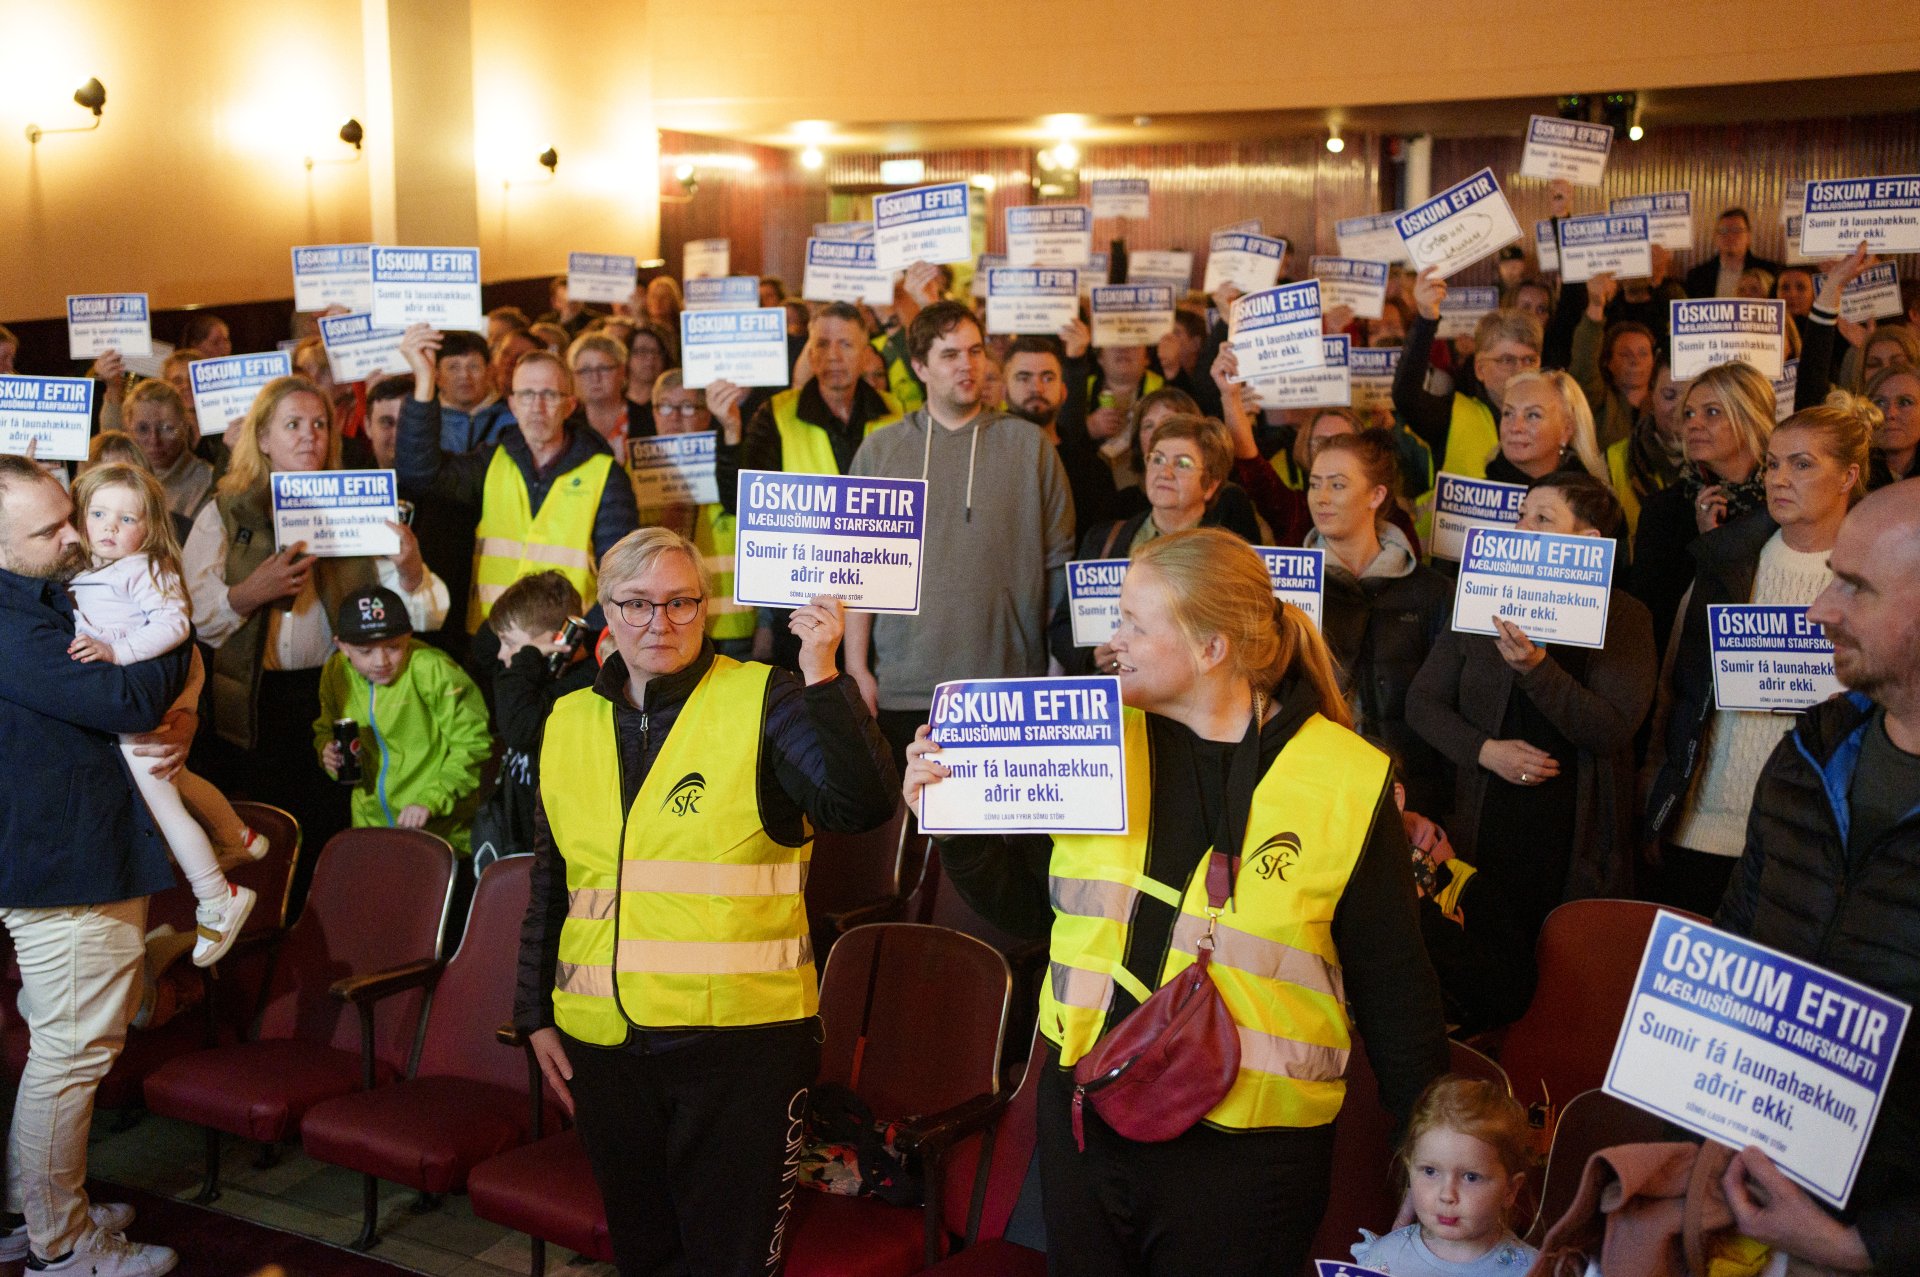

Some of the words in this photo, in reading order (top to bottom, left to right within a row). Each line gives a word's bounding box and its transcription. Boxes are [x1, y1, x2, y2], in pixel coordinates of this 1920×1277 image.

[1813, 183, 1869, 201] ÓSKUM
[1875, 180, 1920, 197] EFTIR
[879, 195, 922, 216] ÓSKUM
[926, 189, 962, 209] EFTIR
[1401, 206, 1450, 236] ÓSKUM
[1452, 176, 1492, 208] EFTIR
[1564, 221, 1606, 237] ÓSKUM
[1610, 218, 1643, 233] EFTIR
[1810, 218, 1836, 228] Sumir
[1839, 218, 1848, 227] fá
[1852, 214, 1920, 227] launahækkun,
[1838, 229, 1860, 239] aðrir
[1864, 228, 1888, 238] ekki.
[377, 249, 427, 269] ÓSKUM
[433, 254, 472, 270] EFTIR
[1280, 287, 1318, 311] EFTIR
[688, 314, 735, 333] ÓSKUM
[741, 314, 779, 330] EFTIR
[1678, 304, 1734, 324] ÓSKUM
[1740, 305, 1777, 323] EFTIR
[1256, 336, 1264, 347] fá
[1678, 341, 1705, 351] Sumir
[1709, 341, 1718, 349] fá
[1721, 341, 1777, 351] launahækkun,
[1258, 348, 1278, 361] aðrir
[1282, 344, 1302, 356] ekki.
[1708, 353, 1731, 363] aðrir
[196, 362, 245, 382] ÓSKUM
[248, 357, 286, 375] EFTIR
[0, 376, 37, 397] SKUM
[42, 382, 86, 400] EFTIR
[9, 416, 17, 426] fá
[21, 416, 84, 431] launahækkun,
[8, 429, 28, 440] aðrir
[279, 475, 336, 495] ÓSKUM
[342, 476, 388, 494] EFTIR
[1443, 481, 1502, 508] ÓSKUM
[750, 476, 836, 512] ÓSKUM
[845, 487, 914, 516] EFTIR
[1442, 502, 1497, 519] NÆGJUSÖMUM
[748, 510, 830, 529] NÆGJUSÖMUM
[834, 516, 913, 534] STARFSKRAFTI
[1439, 519, 1467, 533] Sumir
[746, 541, 787, 559] Sumir
[792, 543, 805, 560] fá
[811, 544, 912, 568] launahækkun,
[1471, 530, 1541, 562] ÓSKUM
[1546, 542, 1604, 568] EFTIR
[791, 565, 824, 583] aðrir
[829, 567, 864, 585] ekki.
[1266, 555, 1315, 576] EFTIR
[1468, 556, 1534, 574] NÆGJUSÖMUM
[1536, 565, 1602, 582] STARFSKRAFTI
[1076, 587, 1120, 596] NÆGJUSÖM
[1273, 577, 1315, 589] RFSKRAFTI
[848, 593, 863, 601] STÖRF
[1464, 580, 1498, 596] Sumir
[1501, 585, 1513, 598] fá
[1516, 587, 1600, 610] launahækkun,
[1078, 605, 1107, 616] Sumir
[1110, 605, 1119, 616] fá
[1499, 602, 1527, 617] aðrir
[1530, 605, 1558, 620] ekki.
[1718, 608, 1787, 634] ÓSKUM
[1719, 636, 1785, 648] NÆGJUSÖMUM
[1788, 638, 1834, 649] STARFSKR
[1721, 660, 1754, 672] Sumir
[1759, 660, 1769, 673] fá
[1774, 661, 1834, 675] launahækk
[1759, 678, 1785, 690] aðrir
[1790, 679, 1816, 691] ekki.
[935, 687, 1024, 723] ÓSKUM
[1034, 689, 1108, 721] EFTIR
[932, 726, 1021, 742] NÆGJUSÖMUM
[1025, 725, 1111, 740] STARFSKRAFTI
[984, 760, 998, 777] fá
[1005, 759, 1113, 780] launahækkun,
[985, 785, 1021, 802] aðrir
[1028, 784, 1063, 802] ekki.
[1663, 927, 1792, 1011] ÓSKUM
[1796, 981, 1888, 1055] EFTIR
[1653, 973, 1774, 1034] NÆGJUSÖMUM
[1776, 1020, 1877, 1081] STARFSKRAFTI
[1639, 1011, 1701, 1052] Sumir
[1705, 1037, 1727, 1065] fá
[1733, 1048, 1859, 1132] launahækkun,
[1694, 1072, 1746, 1105] aðrir
[1752, 1094, 1794, 1131] ekki.
